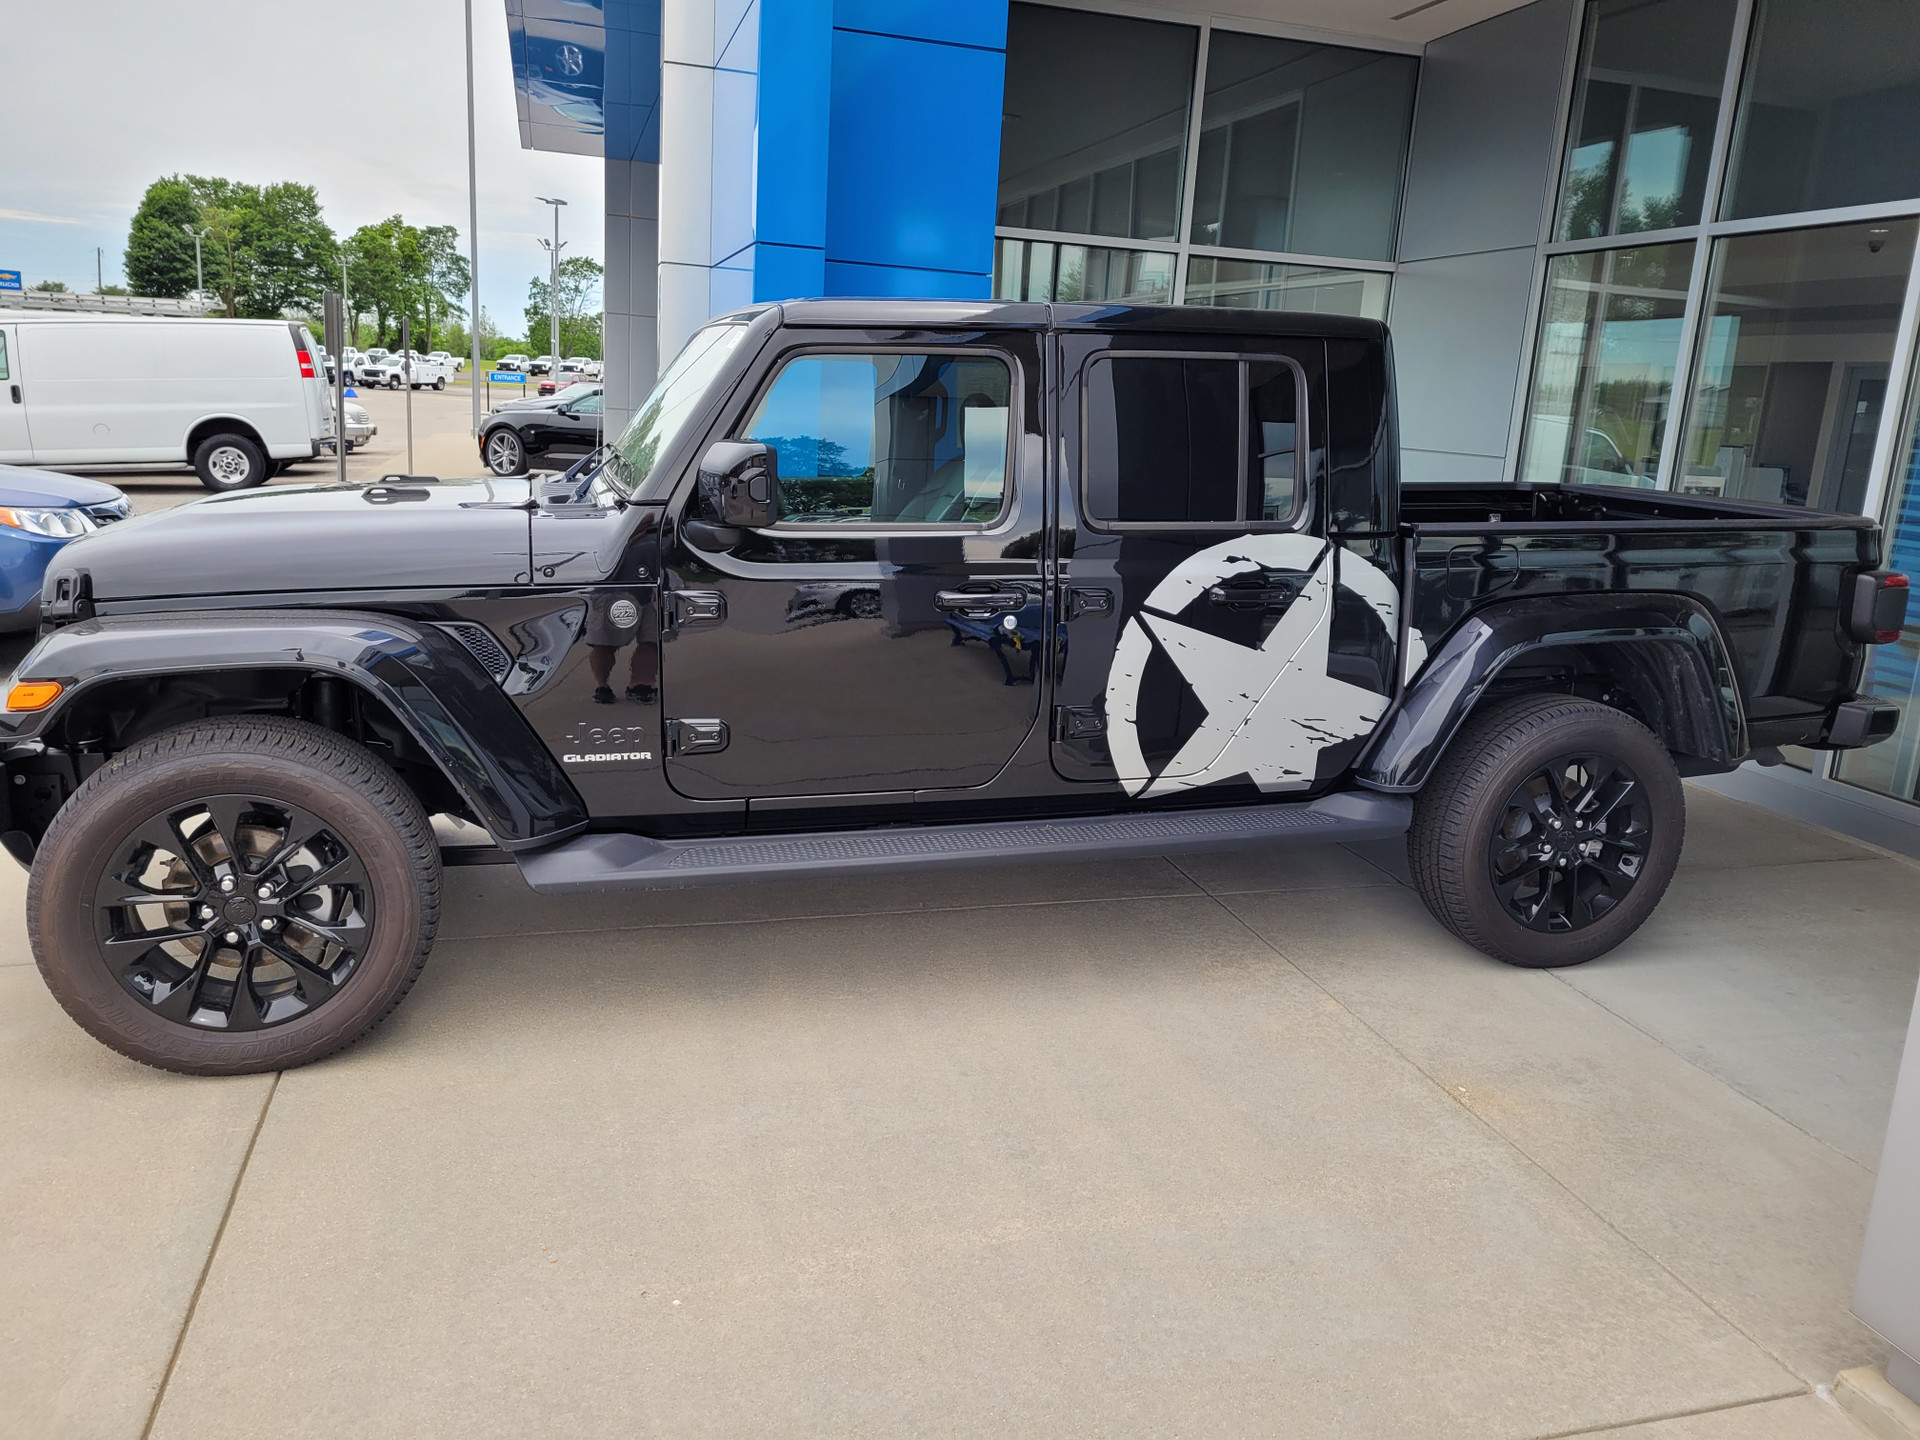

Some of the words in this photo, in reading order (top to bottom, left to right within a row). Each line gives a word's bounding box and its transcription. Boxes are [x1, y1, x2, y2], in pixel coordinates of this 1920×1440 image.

[494, 374, 522, 382] ENTRANCE
[565, 722, 646, 749] Jeep
[563, 752, 652, 763] GLADIATOR
